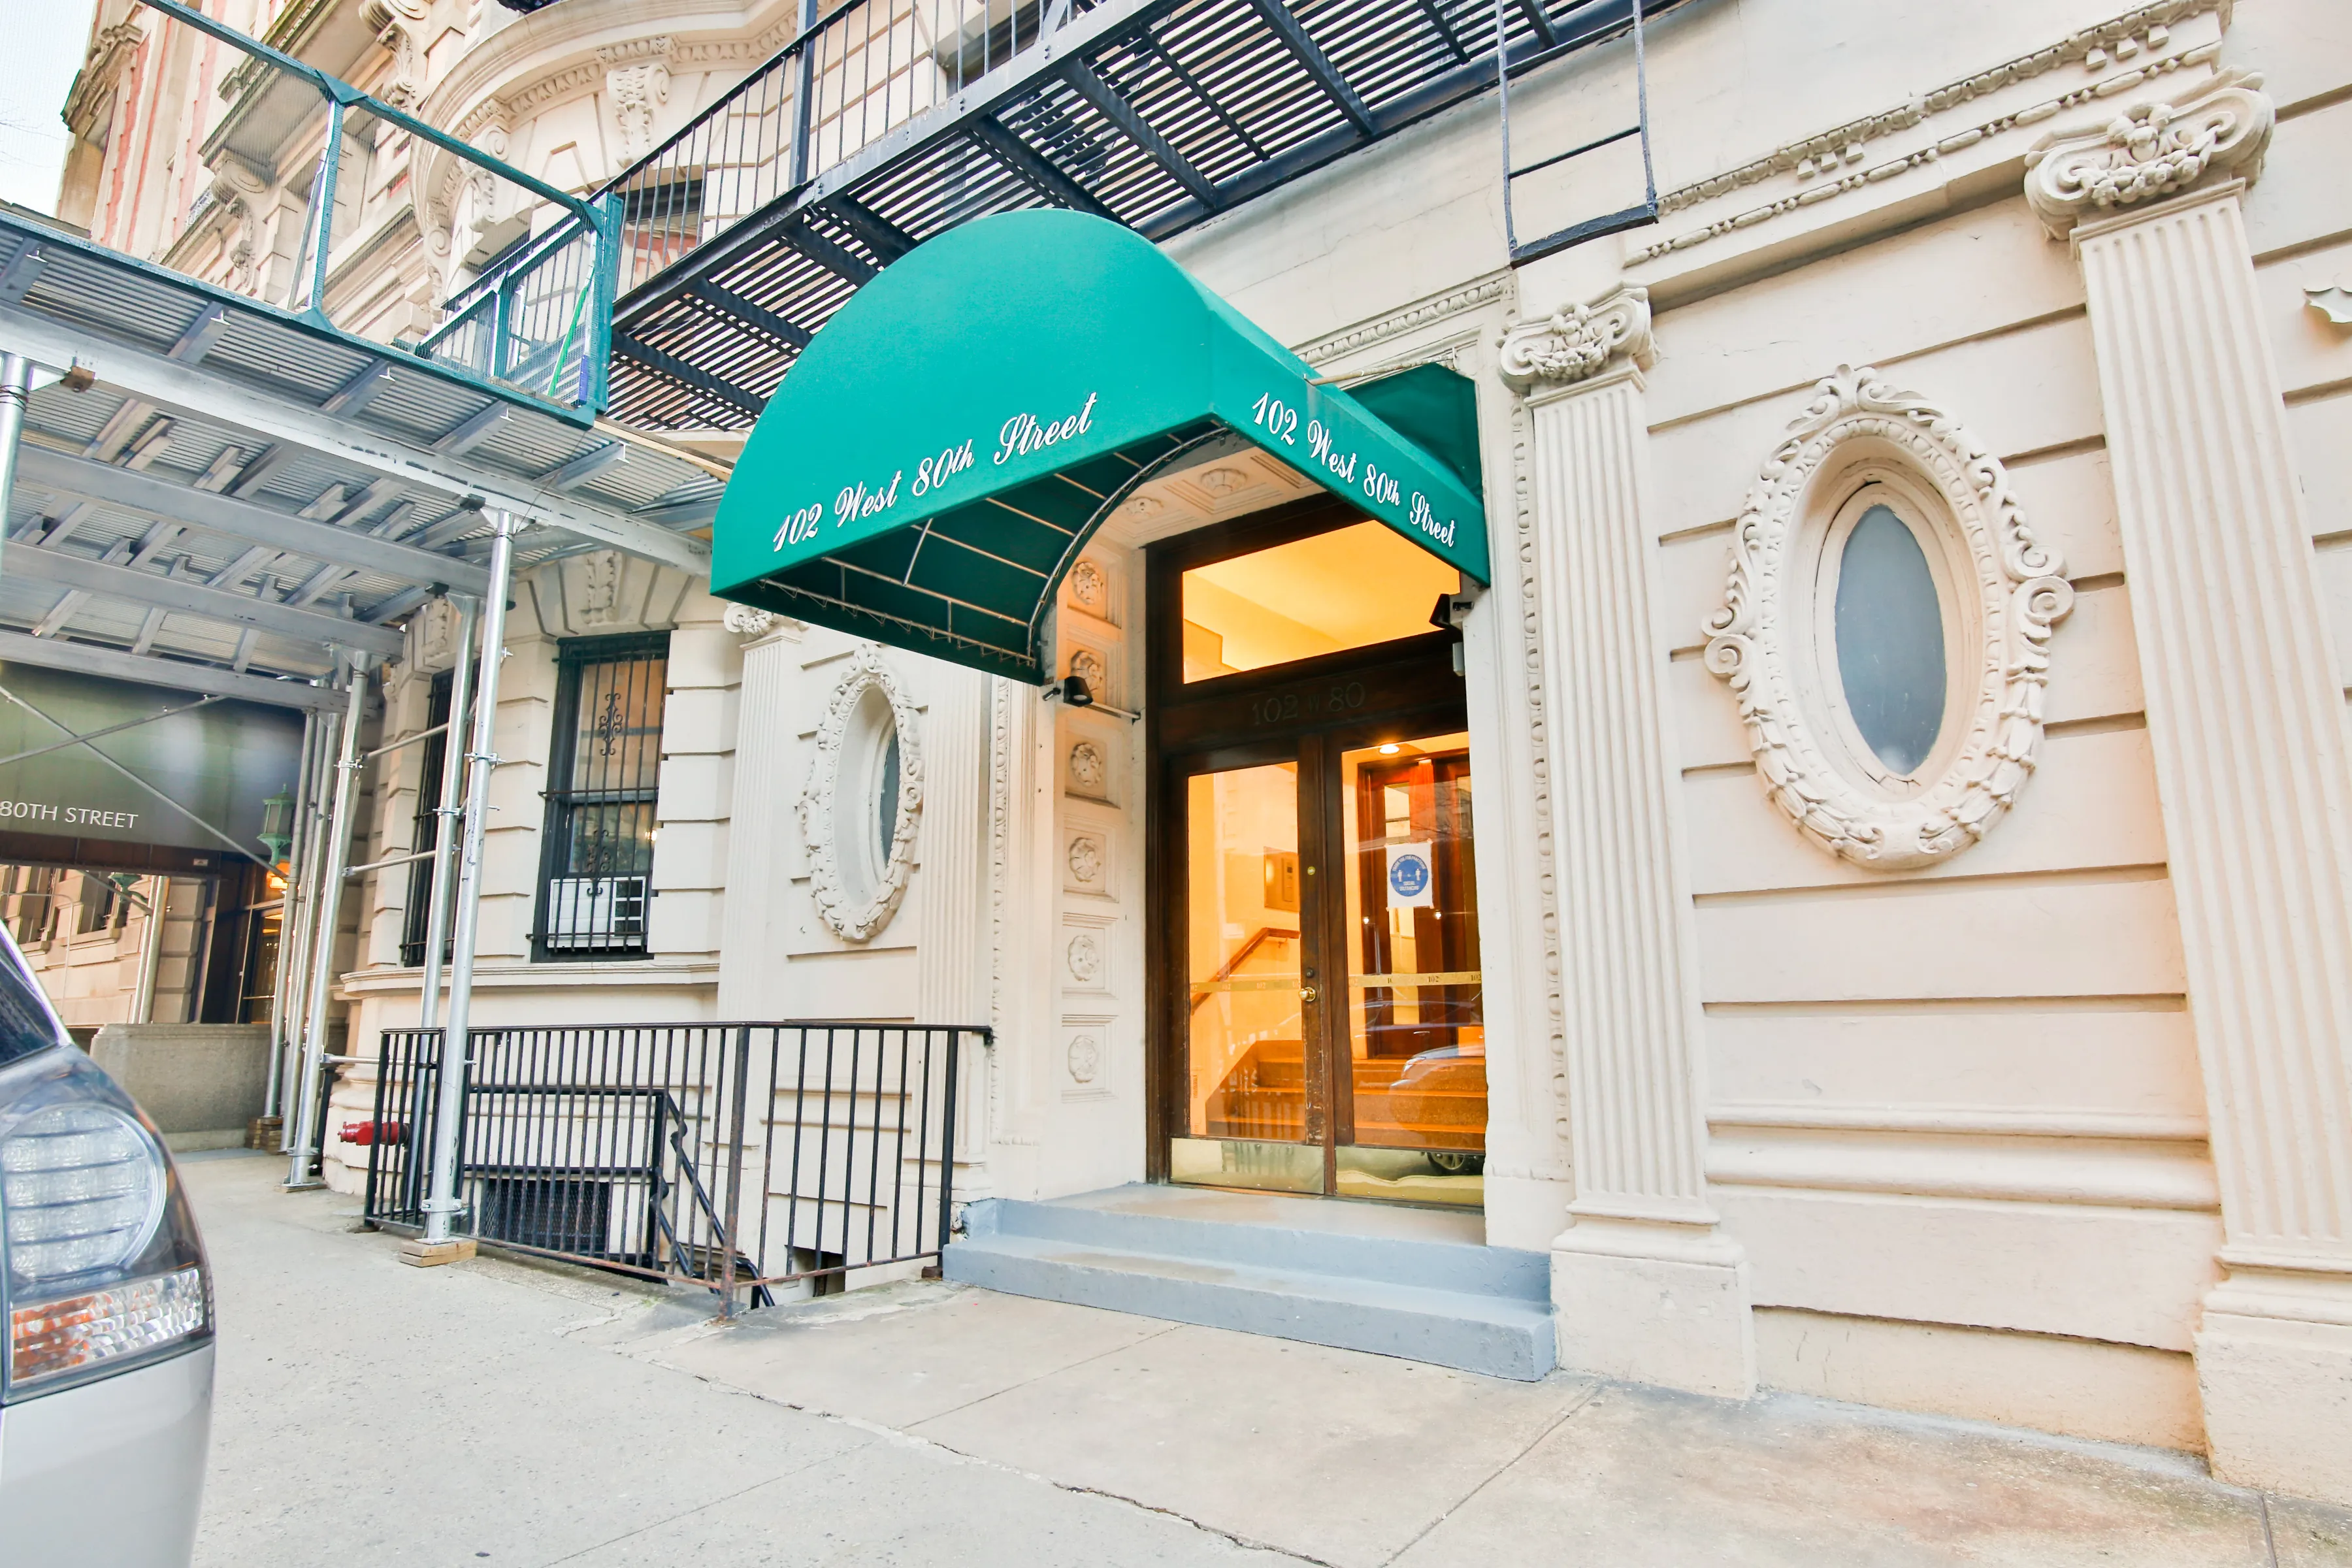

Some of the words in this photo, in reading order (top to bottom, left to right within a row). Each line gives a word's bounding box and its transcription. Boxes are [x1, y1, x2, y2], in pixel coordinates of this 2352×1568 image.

[773, 503, 823, 553] 102
[834, 470, 902, 528] West
[911, 438, 975, 497] 80th
[993, 391, 1098, 466] Street
[1252, 392, 1298, 446] 102
[1307, 419, 1358, 484] West
[1364, 463, 1400, 506] 80th
[1409, 491, 1455, 547] Street
[1252, 693, 1298, 726] 102
[1328, 681, 1366, 713] 80
[0, 800, 58, 821] 80TH
[65, 807, 139, 828] STREET
